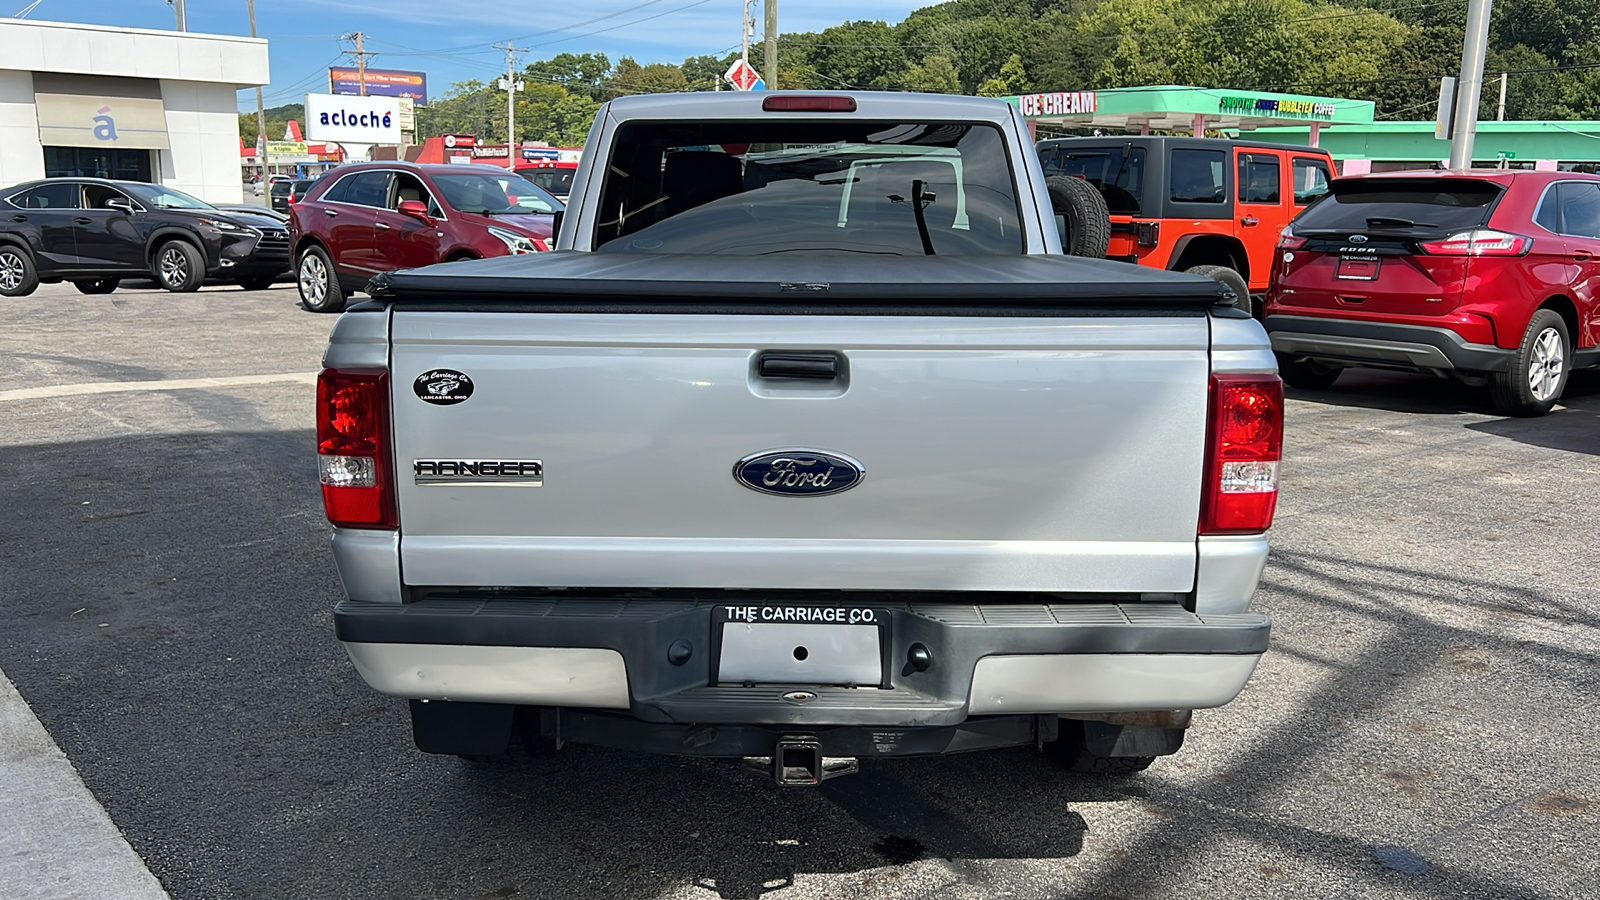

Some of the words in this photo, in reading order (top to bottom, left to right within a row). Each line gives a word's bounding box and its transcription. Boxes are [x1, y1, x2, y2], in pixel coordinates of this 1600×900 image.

[1018, 94, 1042, 116] ICE
[1043, 91, 1097, 114] CREAM
[1313, 102, 1337, 115] COFFEE
[320, 109, 391, 128] acloché
[418, 374, 429, 383] The
[430, 371, 458, 380] Carriage
[415, 460, 542, 476] RANGER
[762, 458, 834, 487] Ford
[725, 606, 757, 620] THE
[761, 606, 846, 621] CARRIAGE
[850, 608, 878, 622] CO.
